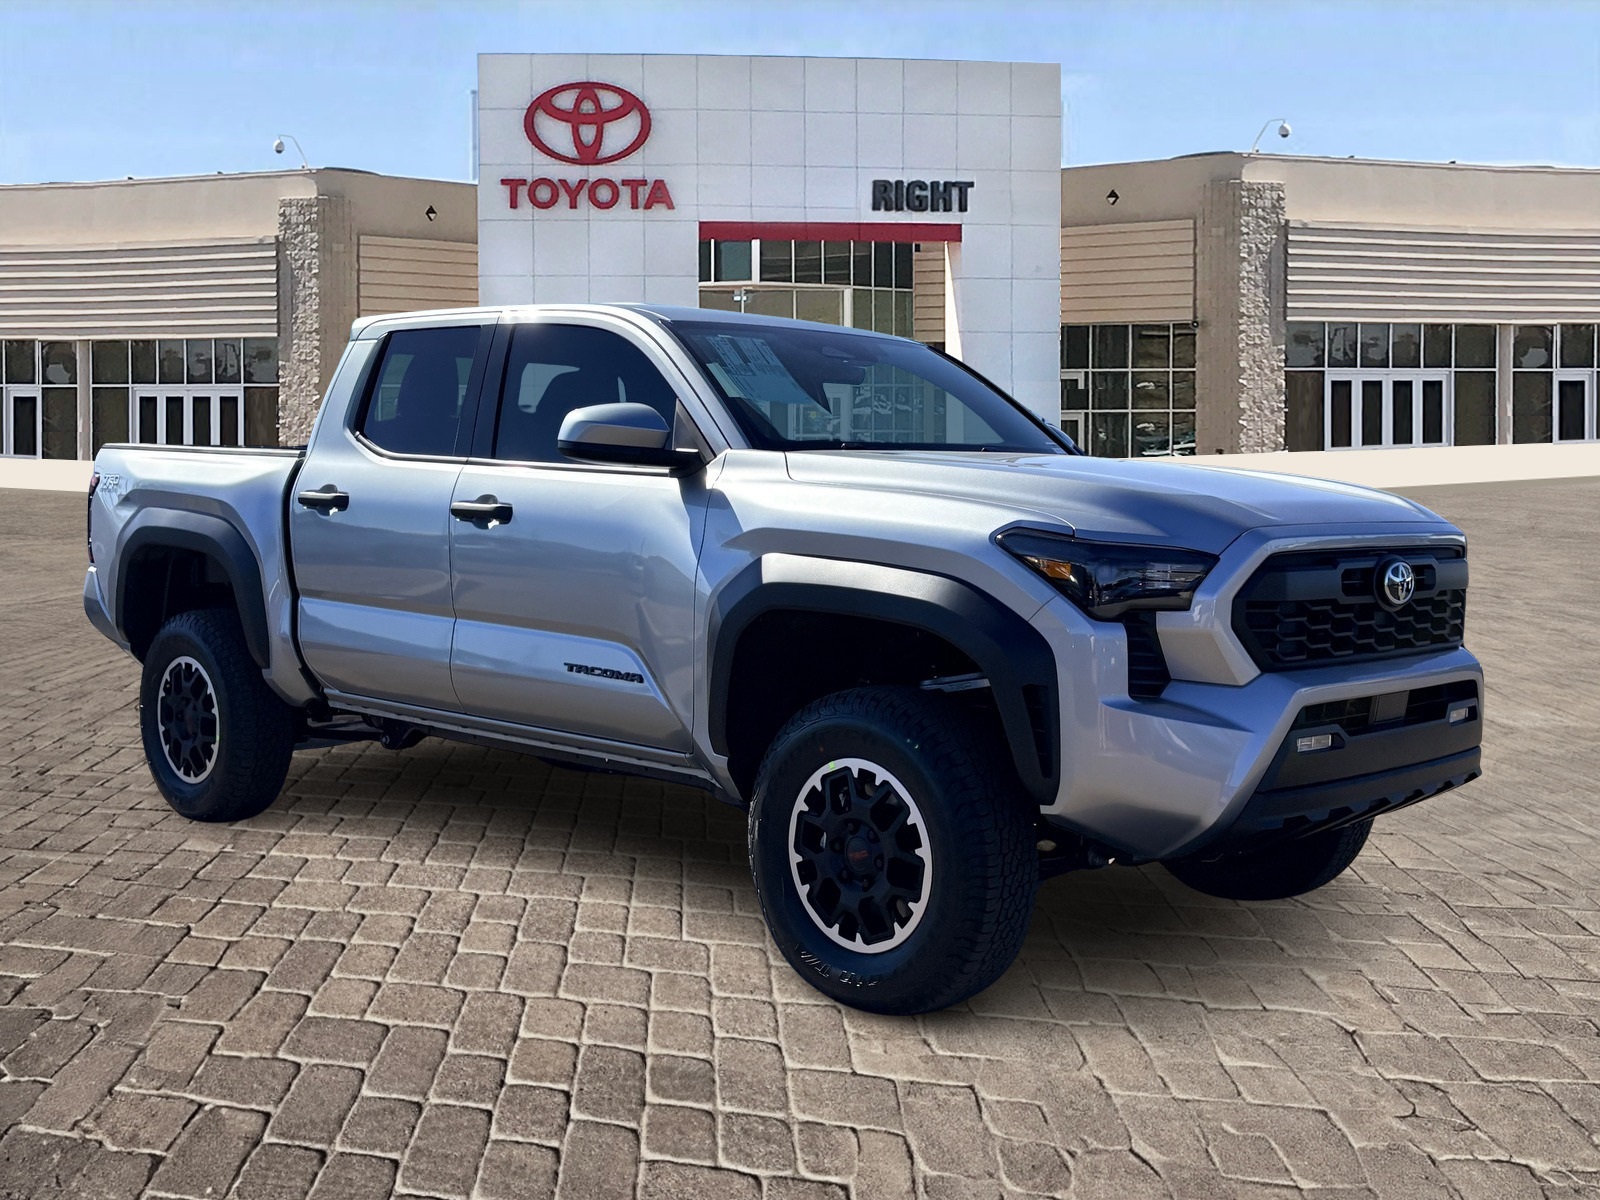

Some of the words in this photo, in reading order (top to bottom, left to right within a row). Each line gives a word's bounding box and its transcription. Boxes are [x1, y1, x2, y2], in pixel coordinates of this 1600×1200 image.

[500, 178, 675, 210] TOYOTA
[871, 179, 975, 212] RIGHT
[563, 662, 644, 683] TACOMA
